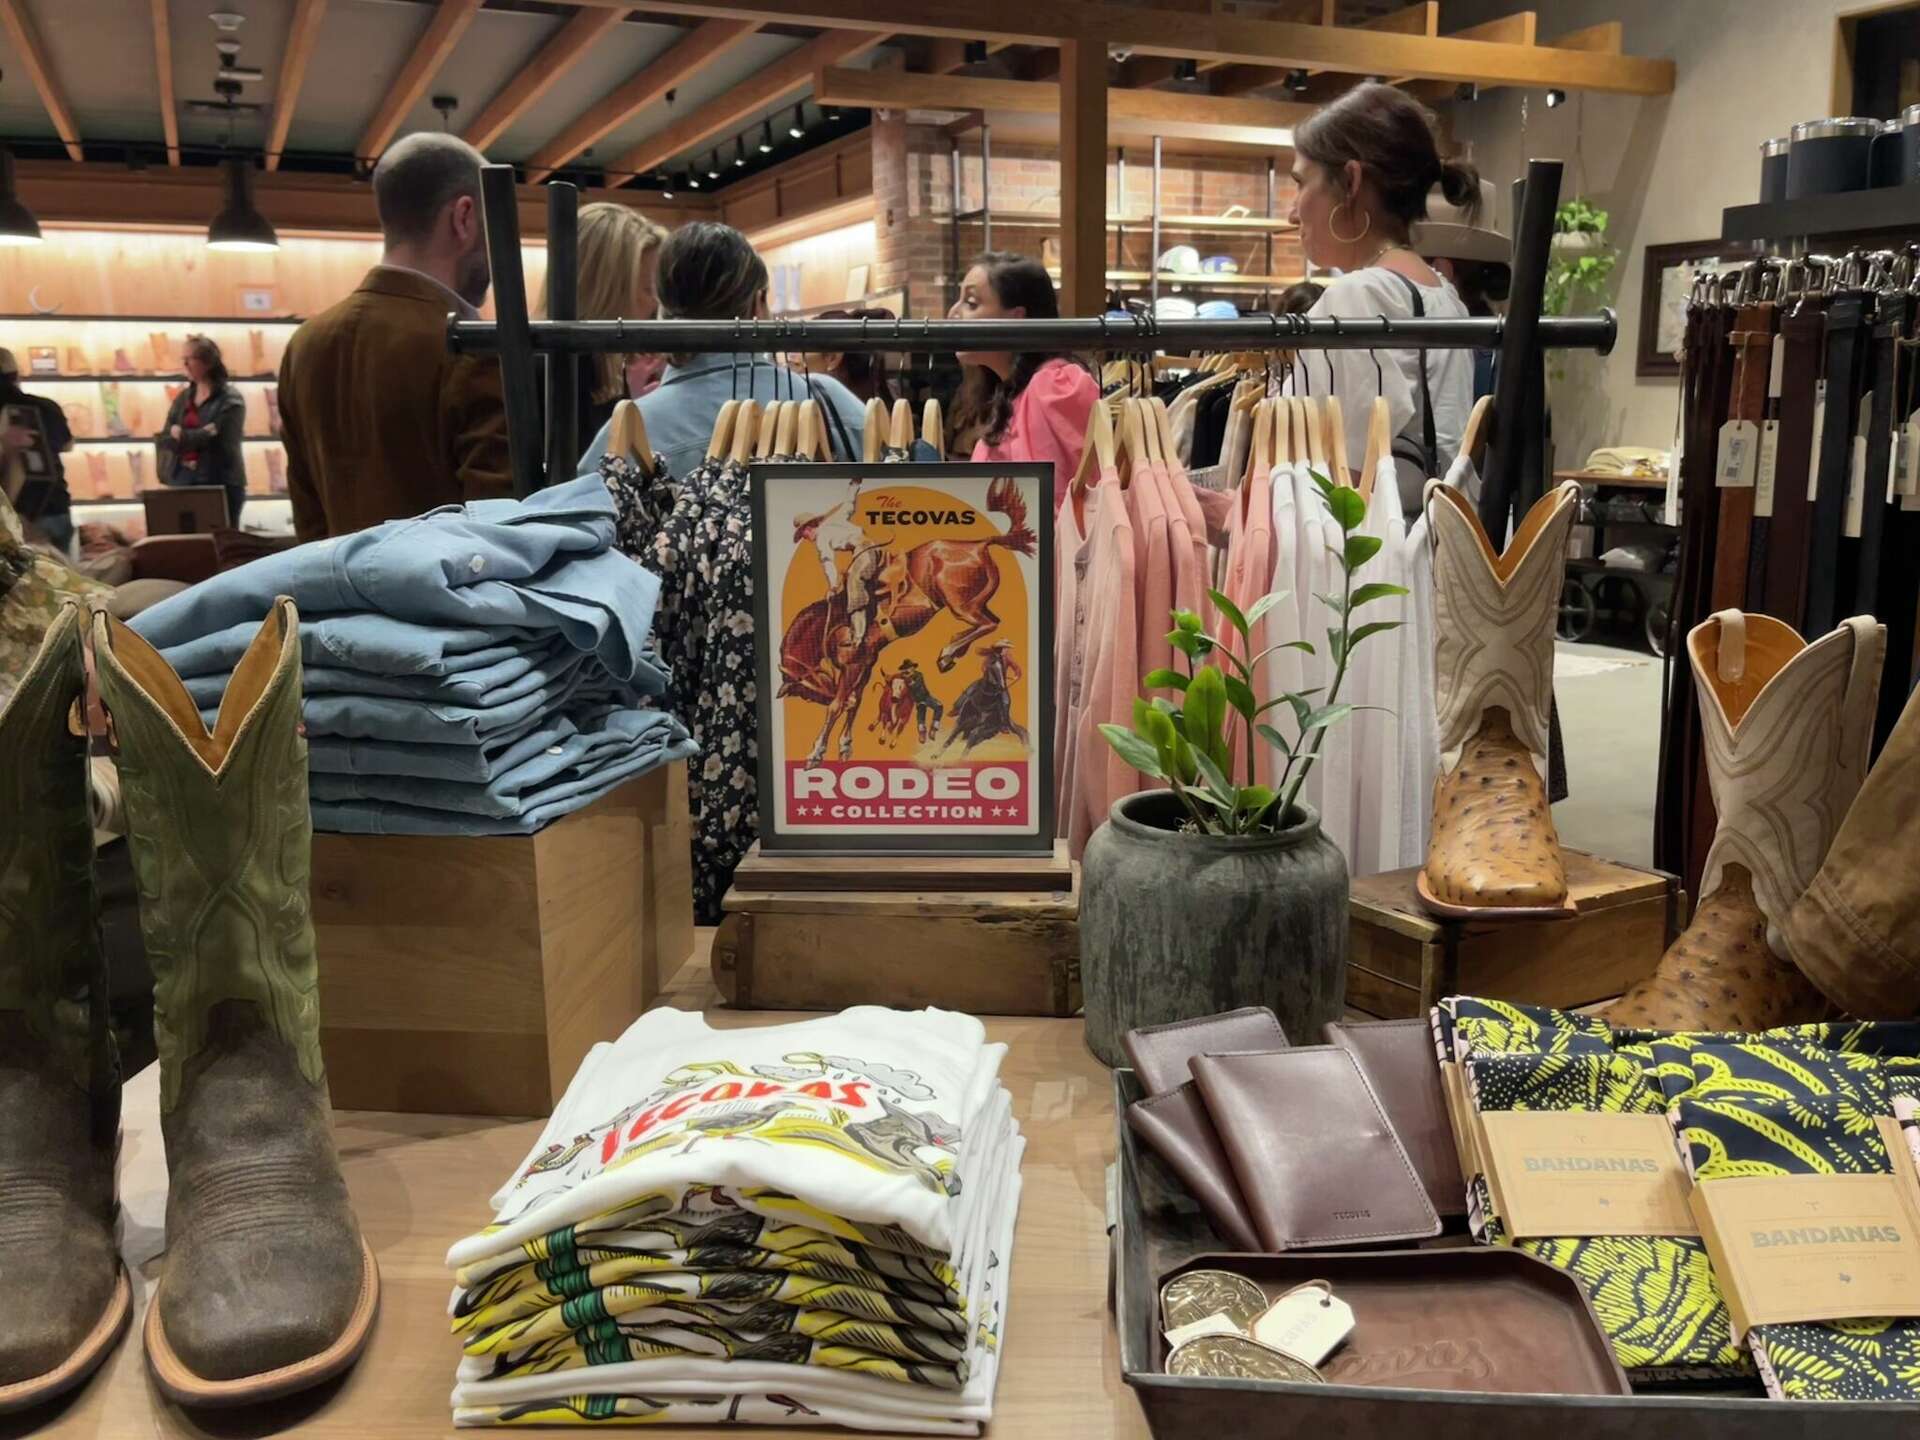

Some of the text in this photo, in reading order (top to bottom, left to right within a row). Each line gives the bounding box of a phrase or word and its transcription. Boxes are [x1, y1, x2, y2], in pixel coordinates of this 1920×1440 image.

[875, 495, 902, 508] The
[865, 510, 976, 525] TECOVAS
[793, 766, 1021, 800] RODEO
[830, 805, 983, 819] COLLECTION
[1525, 1156, 1660, 1173] BANDANAS
[1750, 1226, 1901, 1248] BANDANAS
